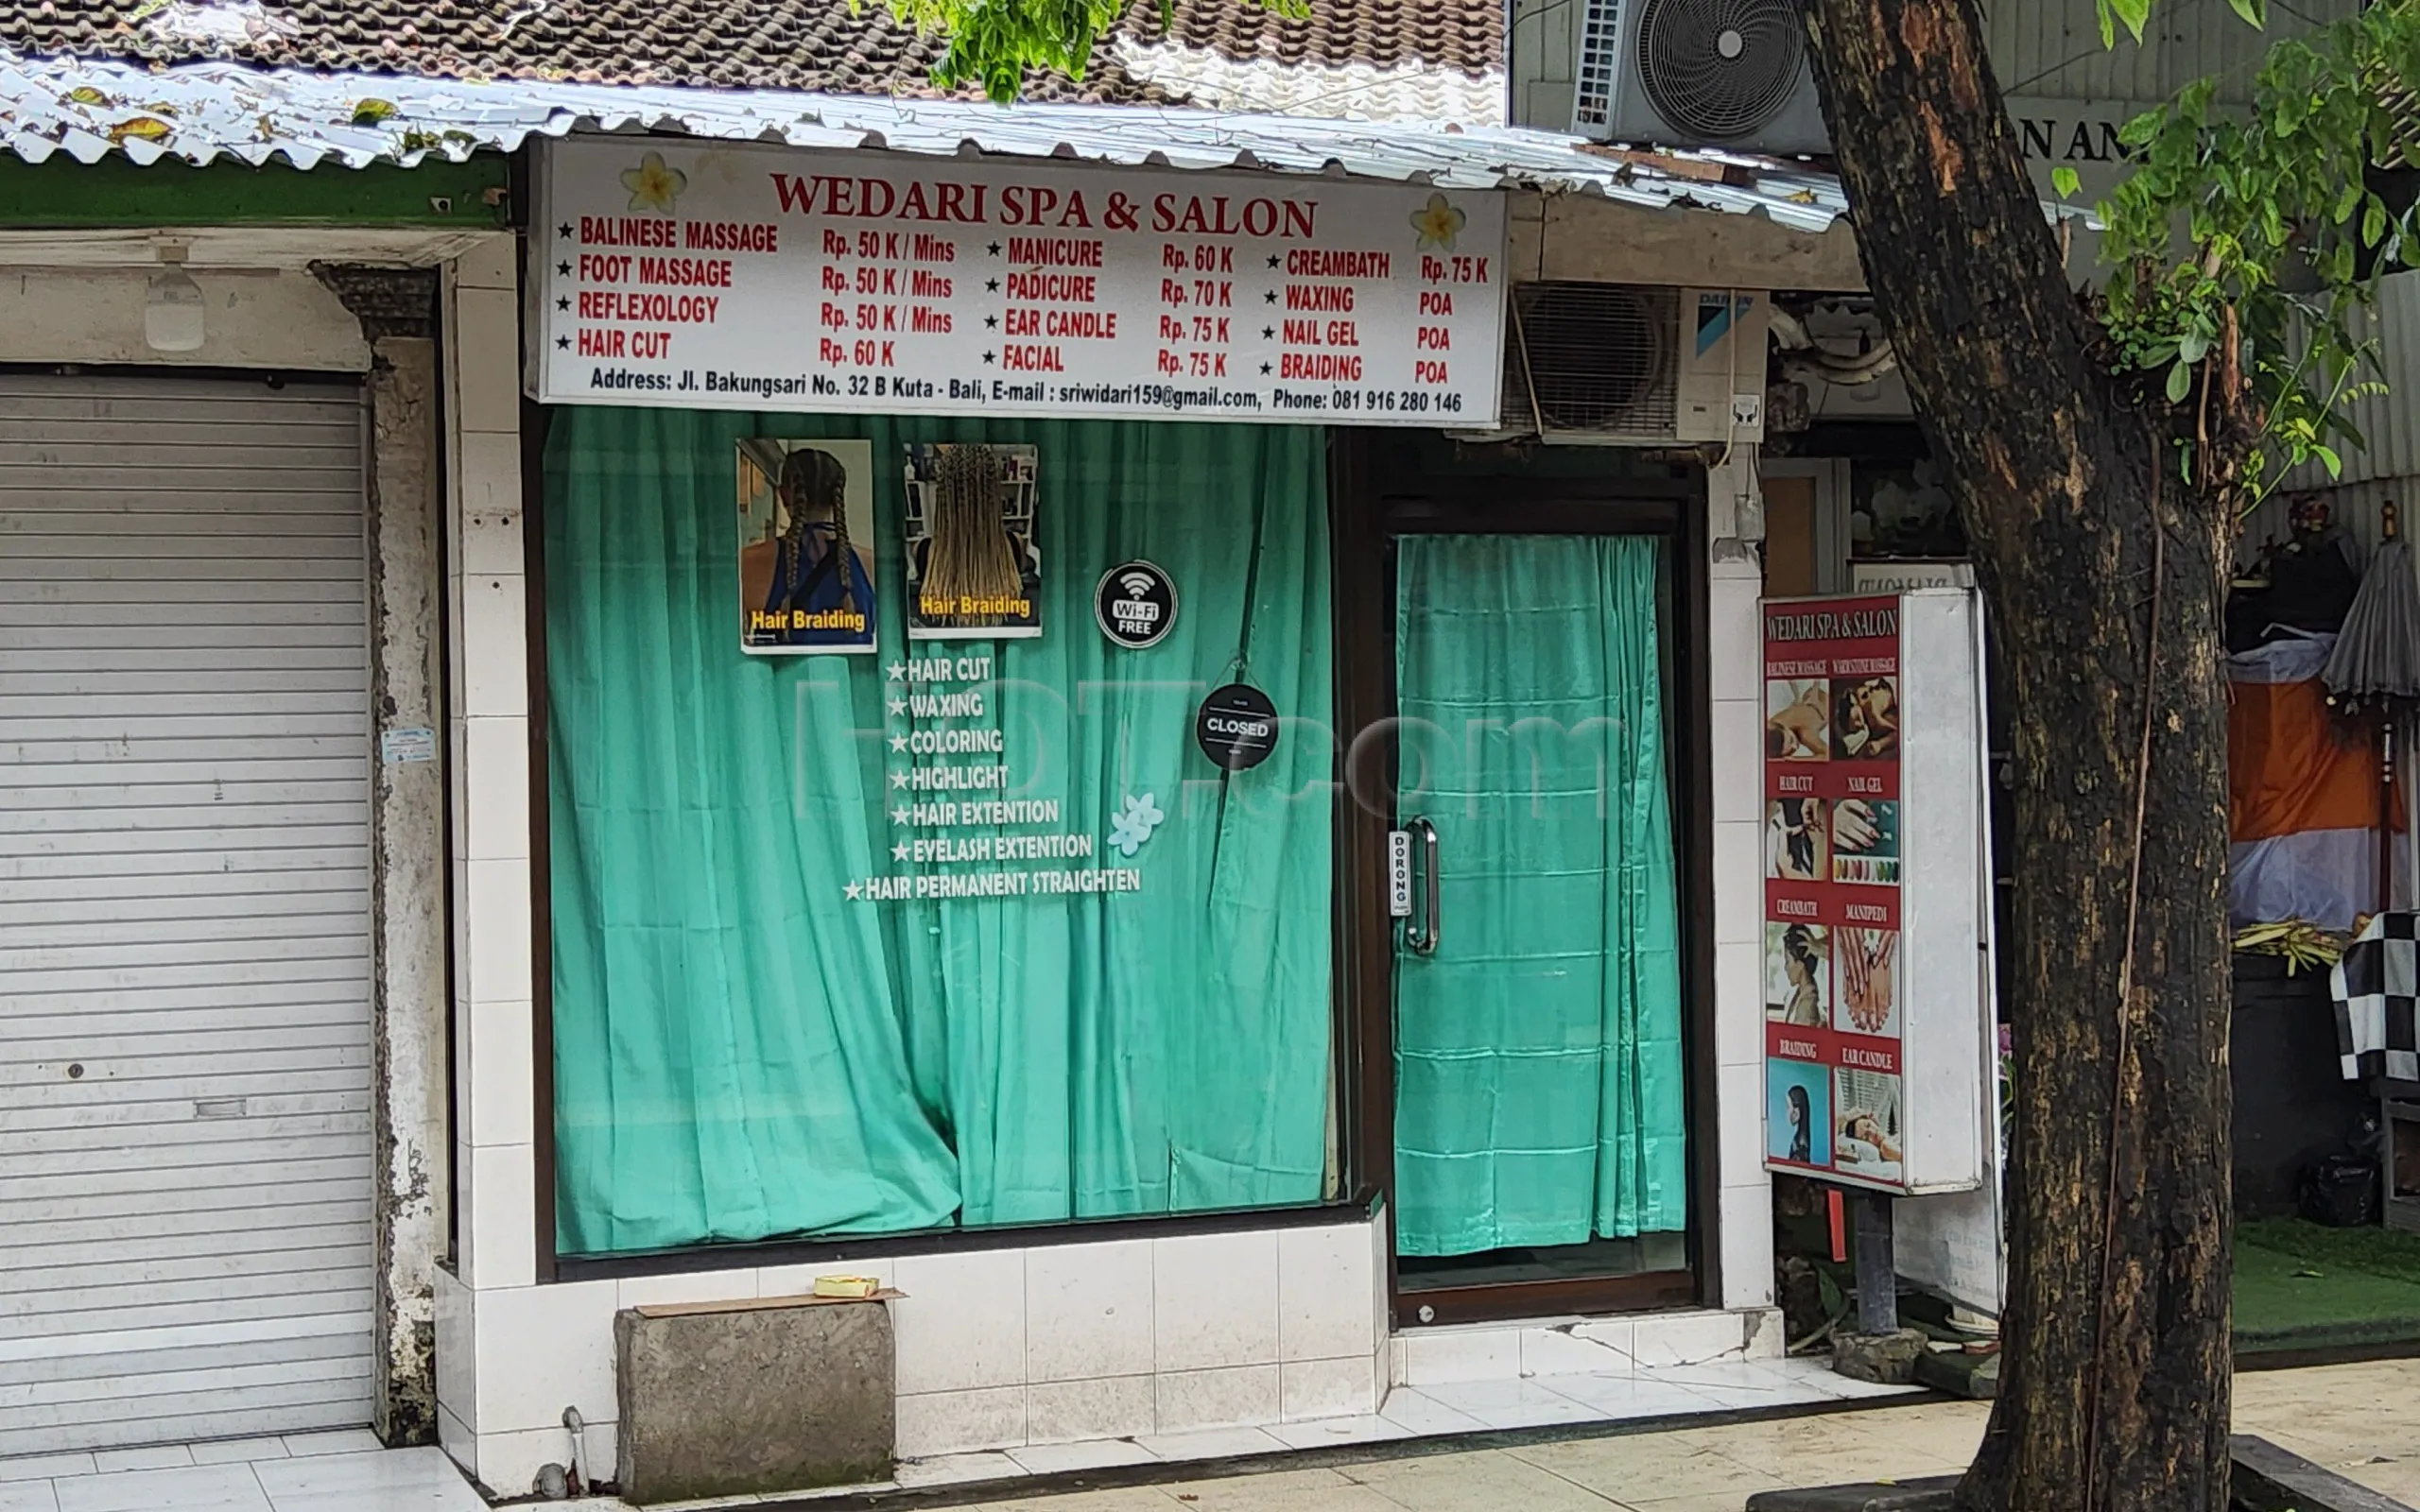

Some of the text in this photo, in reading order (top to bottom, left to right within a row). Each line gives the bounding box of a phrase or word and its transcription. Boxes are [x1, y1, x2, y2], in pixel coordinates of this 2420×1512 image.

[769, 173, 1319, 238] WEDARI SPA & SALON
[580, 216, 778, 252] BALINESE MASSAGE
[822, 230, 851, 263] Rp.
[857, 232, 880, 258] 50
[885, 232, 899, 260] K
[914, 233, 955, 263] Mins
[1008, 237, 1103, 267] MANICURE
[1163, 245, 1234, 273] Rp. 60 K
[1287, 249, 1391, 280] CREAMBATH
[579, 255, 732, 287] FOOT MASSAGE
[821, 266, 850, 299] Rp.
[856, 267, 878, 294] 50
[882, 268, 897, 295] K
[911, 269, 953, 299] Mins
[1421, 255, 1488, 284] Rp. 75 K
[1007, 273, 1097, 303] PADICURE
[1161, 279, 1233, 308] Rp. 70 K
[1286, 284, 1355, 312] WAXING
[579, 291, 718, 323] REFLEXOLOGY
[1420, 292, 1452, 316] POA
[821, 302, 849, 334] Rp.
[856, 303, 878, 331] 50
[882, 304, 897, 333] K
[911, 305, 953, 335] Mins
[1005, 309, 1116, 339] EAR CANDLE
[1159, 315, 1230, 344] Rp. 75 K
[578, 328, 671, 360] HAIR CUT
[1283, 319, 1358, 347] NAIL GEL
[1417, 326, 1450, 351] POA
[820, 337, 895, 368] Rp. 60 K
[1002, 344, 1064, 372] FACIAL
[1157, 349, 1227, 377] Rp. 75 K
[1280, 353, 1362, 381] BRAIDING
[1415, 361, 1447, 384] POA
[591, 368, 671, 392] Address:
[706, 371, 806, 401] Bakungsari
[812, 375, 841, 397] No.
[847, 376, 869, 396] 32
[874, 376, 887, 397] B
[893, 377, 933, 398] Kuta
[949, 378, 987, 404] Bali,
[993, 381, 1045, 403] E-mail
[1272, 390, 1328, 410] Phone:
[1332, 391, 1361, 411] 081
[1366, 392, 1395, 412] 916
[1399, 393, 1428, 413] 280
[1433, 393, 1461, 413] 146
[921, 594, 1030, 617] Hair Braiding
[1116, 602, 1156, 619] Wi-Fi
[751, 609, 865, 632] Hair Braiding
[1118, 620, 1151, 634] FREE
[1767, 610, 1896, 641] WEDARI SPA & SALON
[908, 657, 991, 682] HAIR CUT
[909, 694, 983, 718] WAXING
[910, 729, 1003, 753] COLORING
[1207, 718, 1269, 737] CLOSED
[911, 765, 1009, 790] HIGHLIGHT
[912, 799, 1059, 826] HAIR EXTENTION
[913, 834, 1092, 862] EYELASH EXTENTION
[1394, 836, 1406, 902] DORONG
[866, 868, 1140, 900] HAIR PERMANENT STRAIGHTEN
[1779, 1039, 1817, 1059] BRAIDING
[1842, 1047, 1893, 1070] EAR CANDLE
